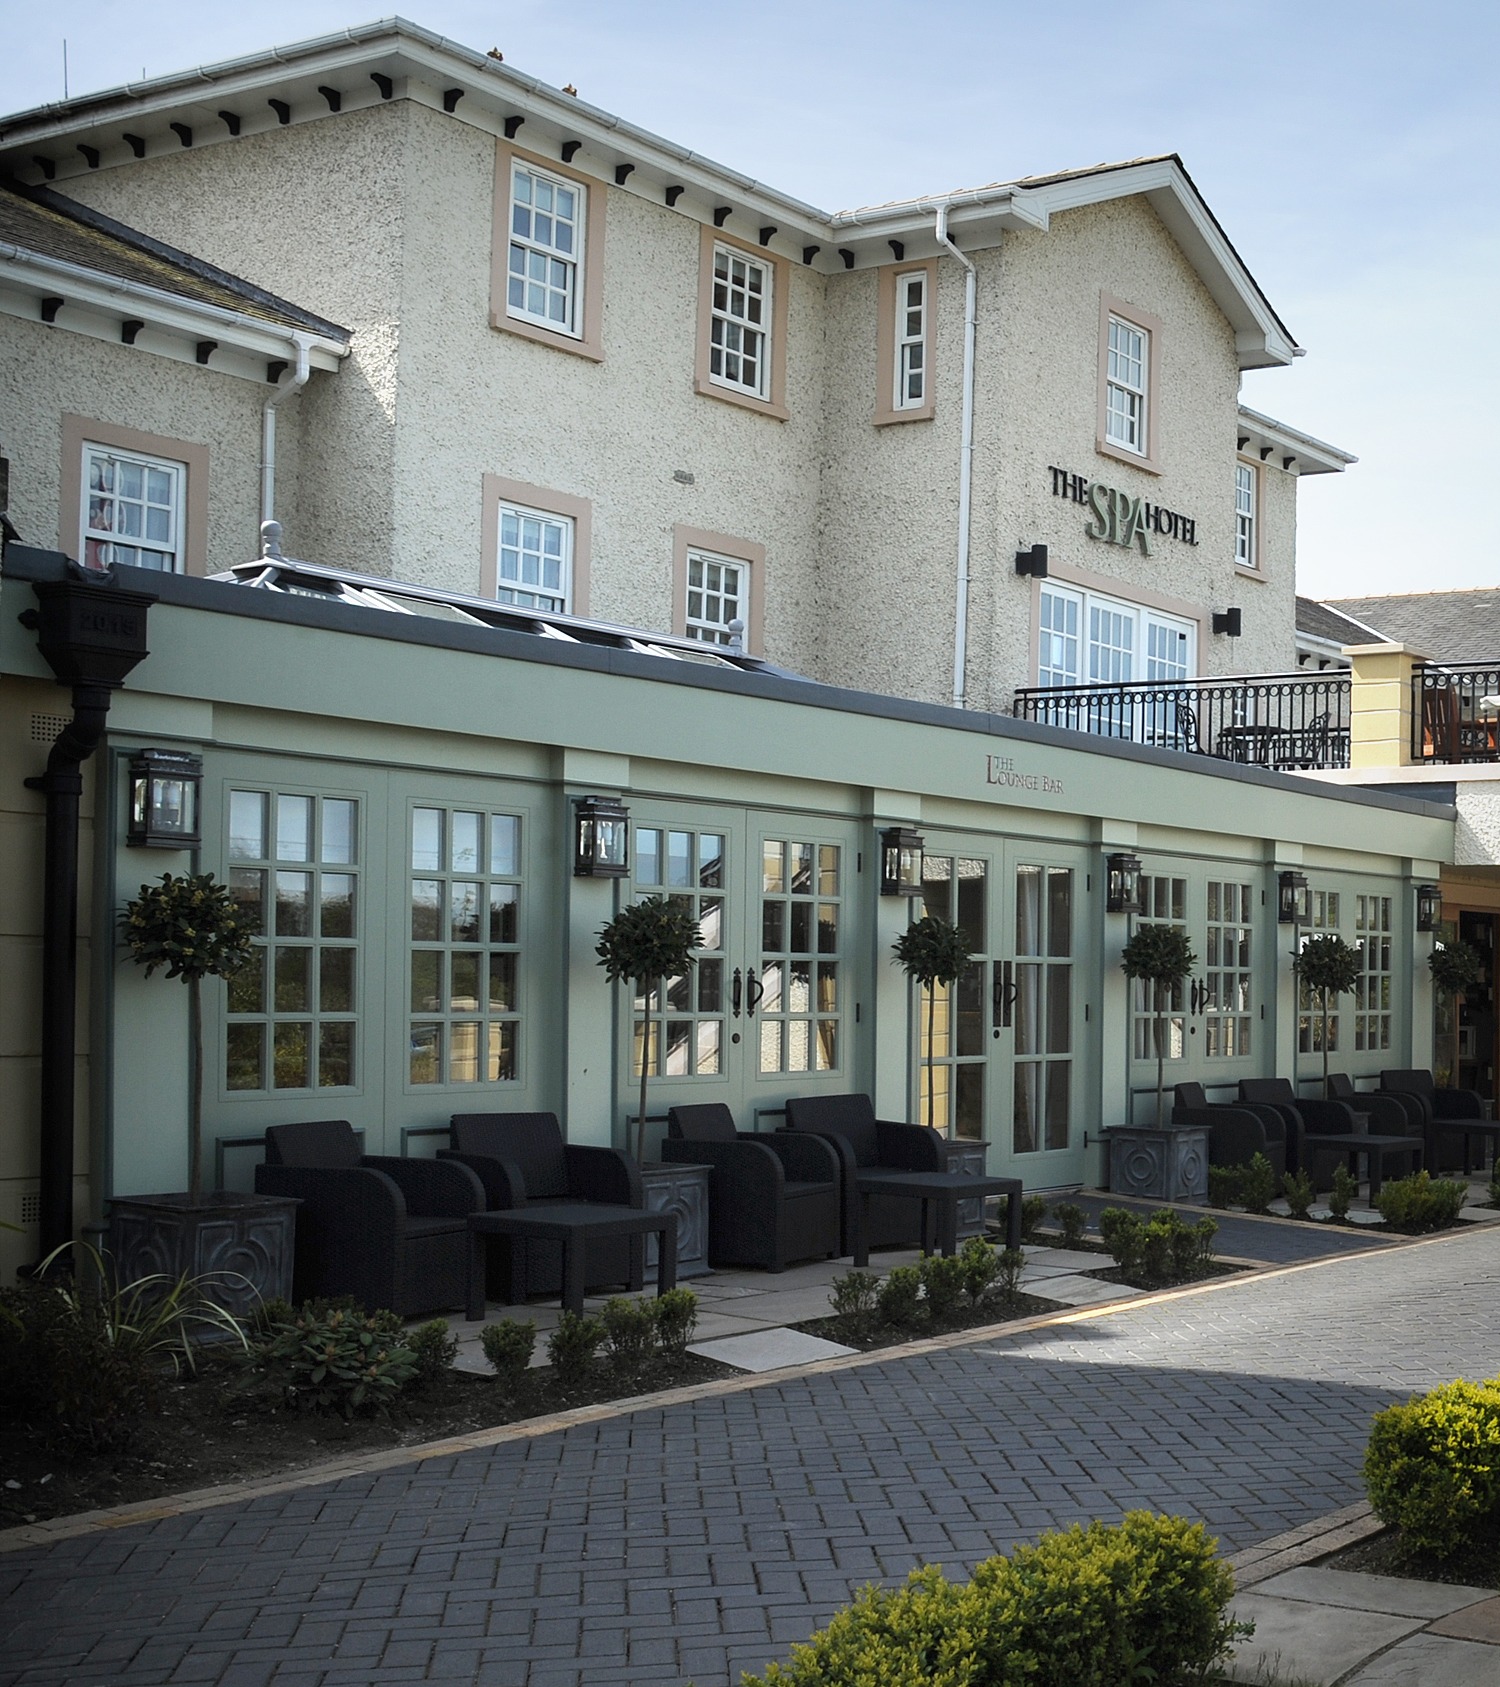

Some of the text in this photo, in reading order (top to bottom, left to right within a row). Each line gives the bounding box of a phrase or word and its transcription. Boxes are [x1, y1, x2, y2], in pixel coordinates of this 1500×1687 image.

[1048, 465, 1199, 557] THE SPA HOTEL
[993, 756, 1014, 771] THE
